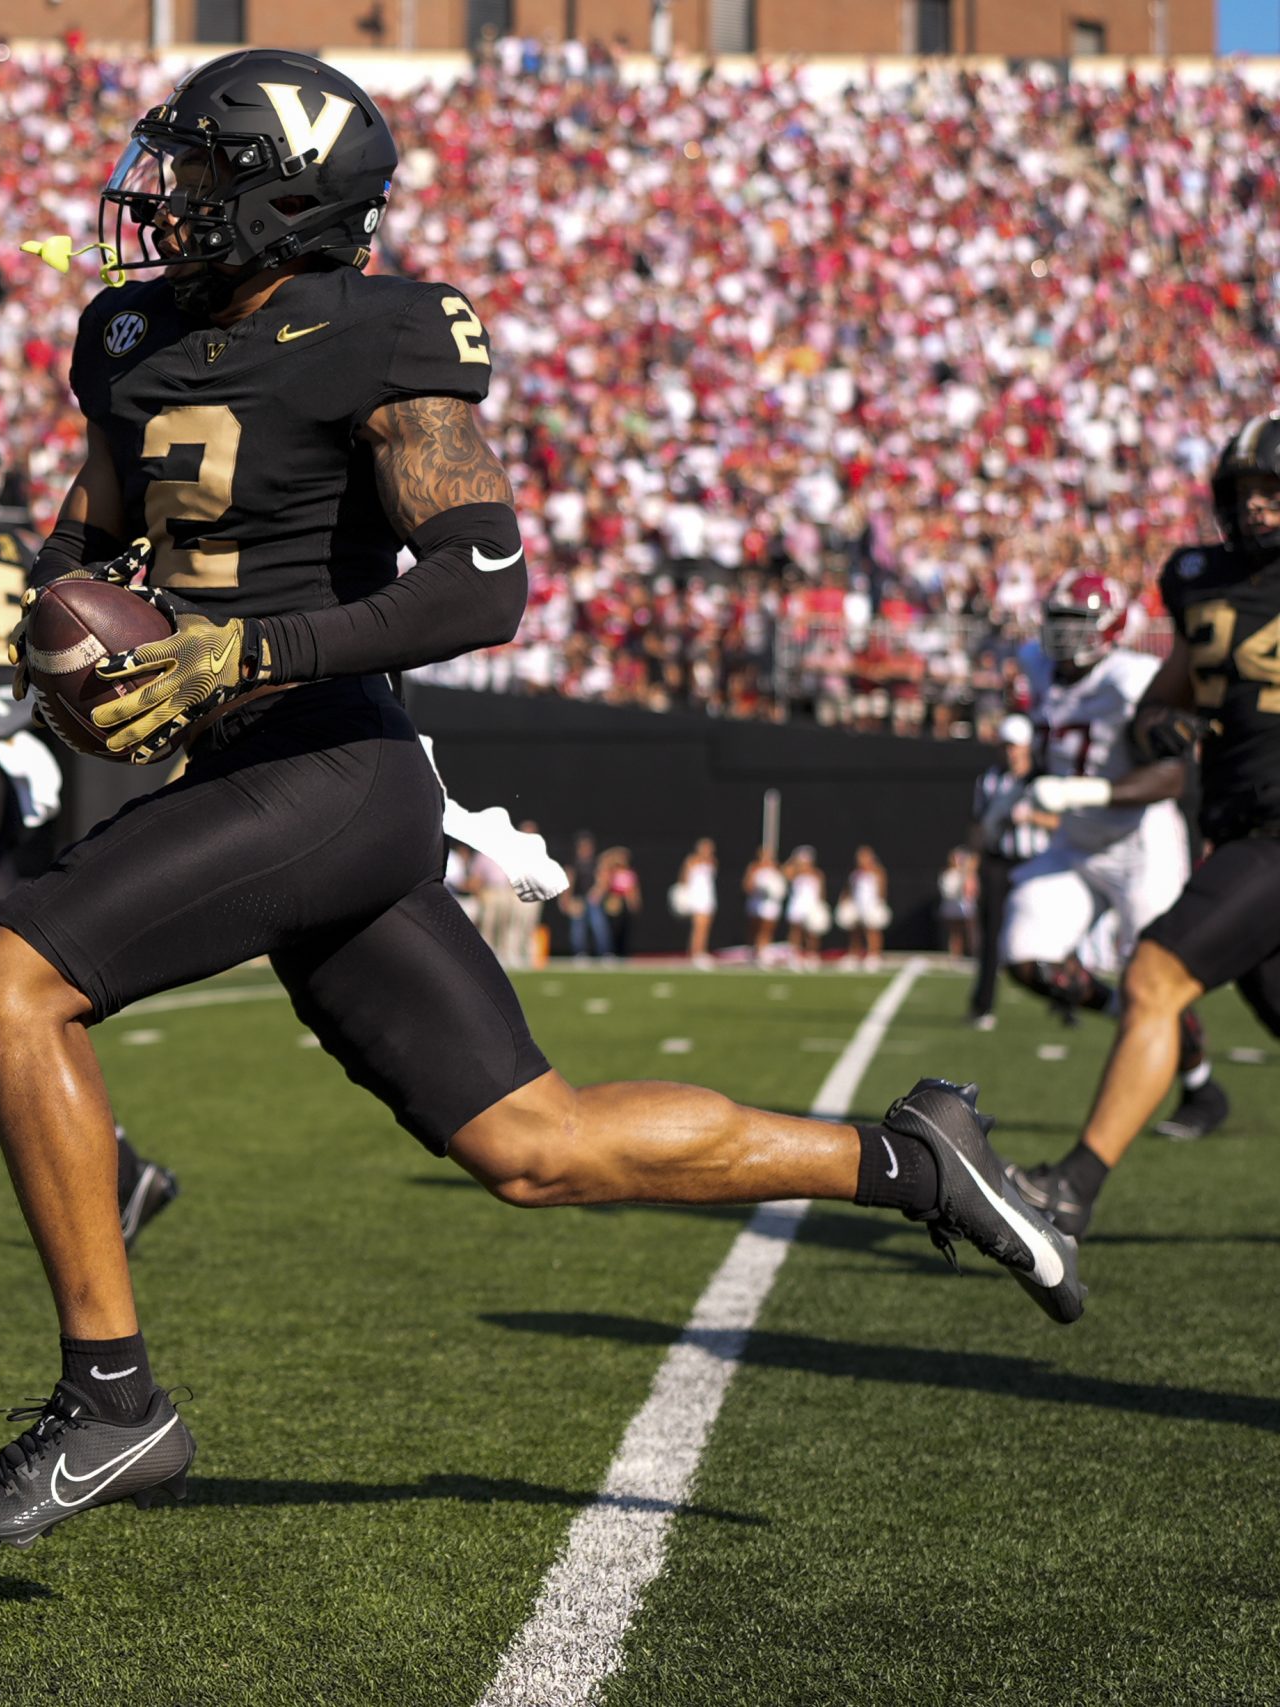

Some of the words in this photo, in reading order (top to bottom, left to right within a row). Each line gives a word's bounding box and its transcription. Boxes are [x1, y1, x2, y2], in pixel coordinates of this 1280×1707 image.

[257, 82, 357, 166] V
[106, 313, 145, 354] SEC
[206, 342, 226, 363] V
[441, 296, 491, 366] 2
[140, 404, 243, 589] 2
